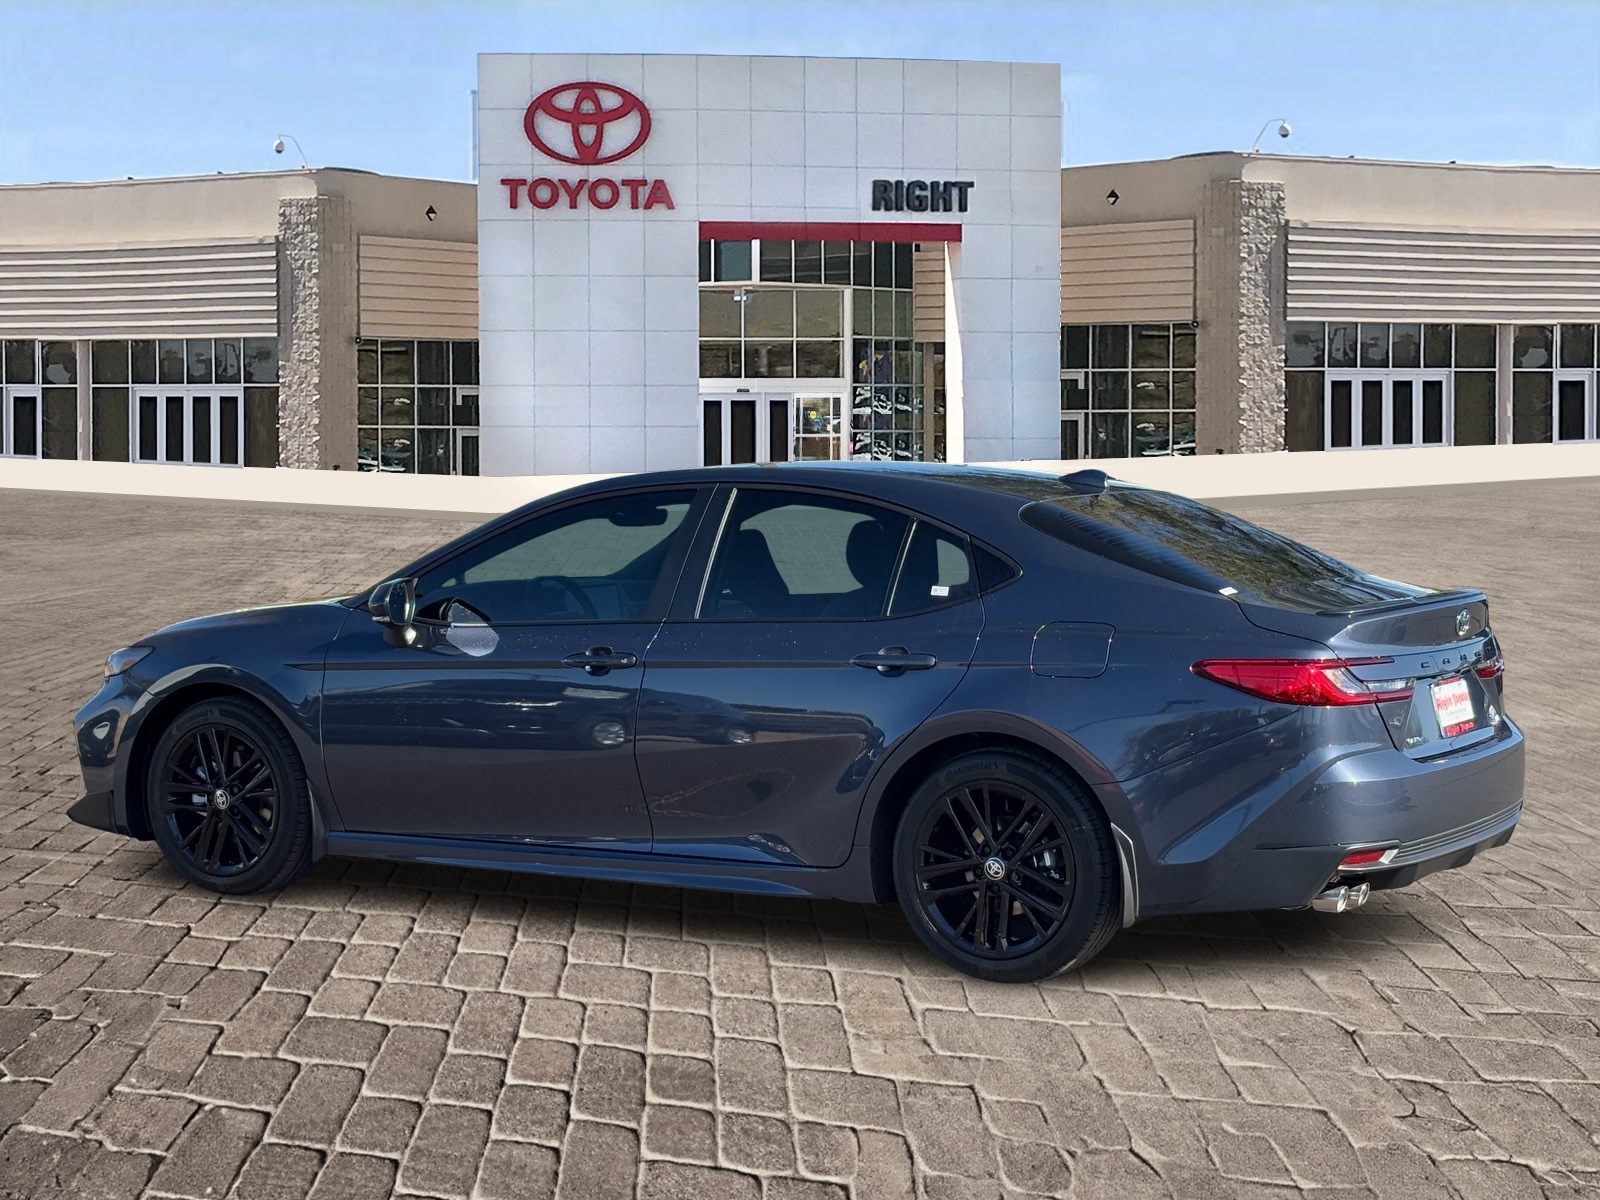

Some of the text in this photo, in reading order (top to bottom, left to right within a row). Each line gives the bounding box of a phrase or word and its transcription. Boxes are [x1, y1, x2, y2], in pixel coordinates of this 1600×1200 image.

[500, 178, 675, 210] TOYOTA
[871, 180, 976, 212] RIGHT
[945, 760, 992, 782] Continental
